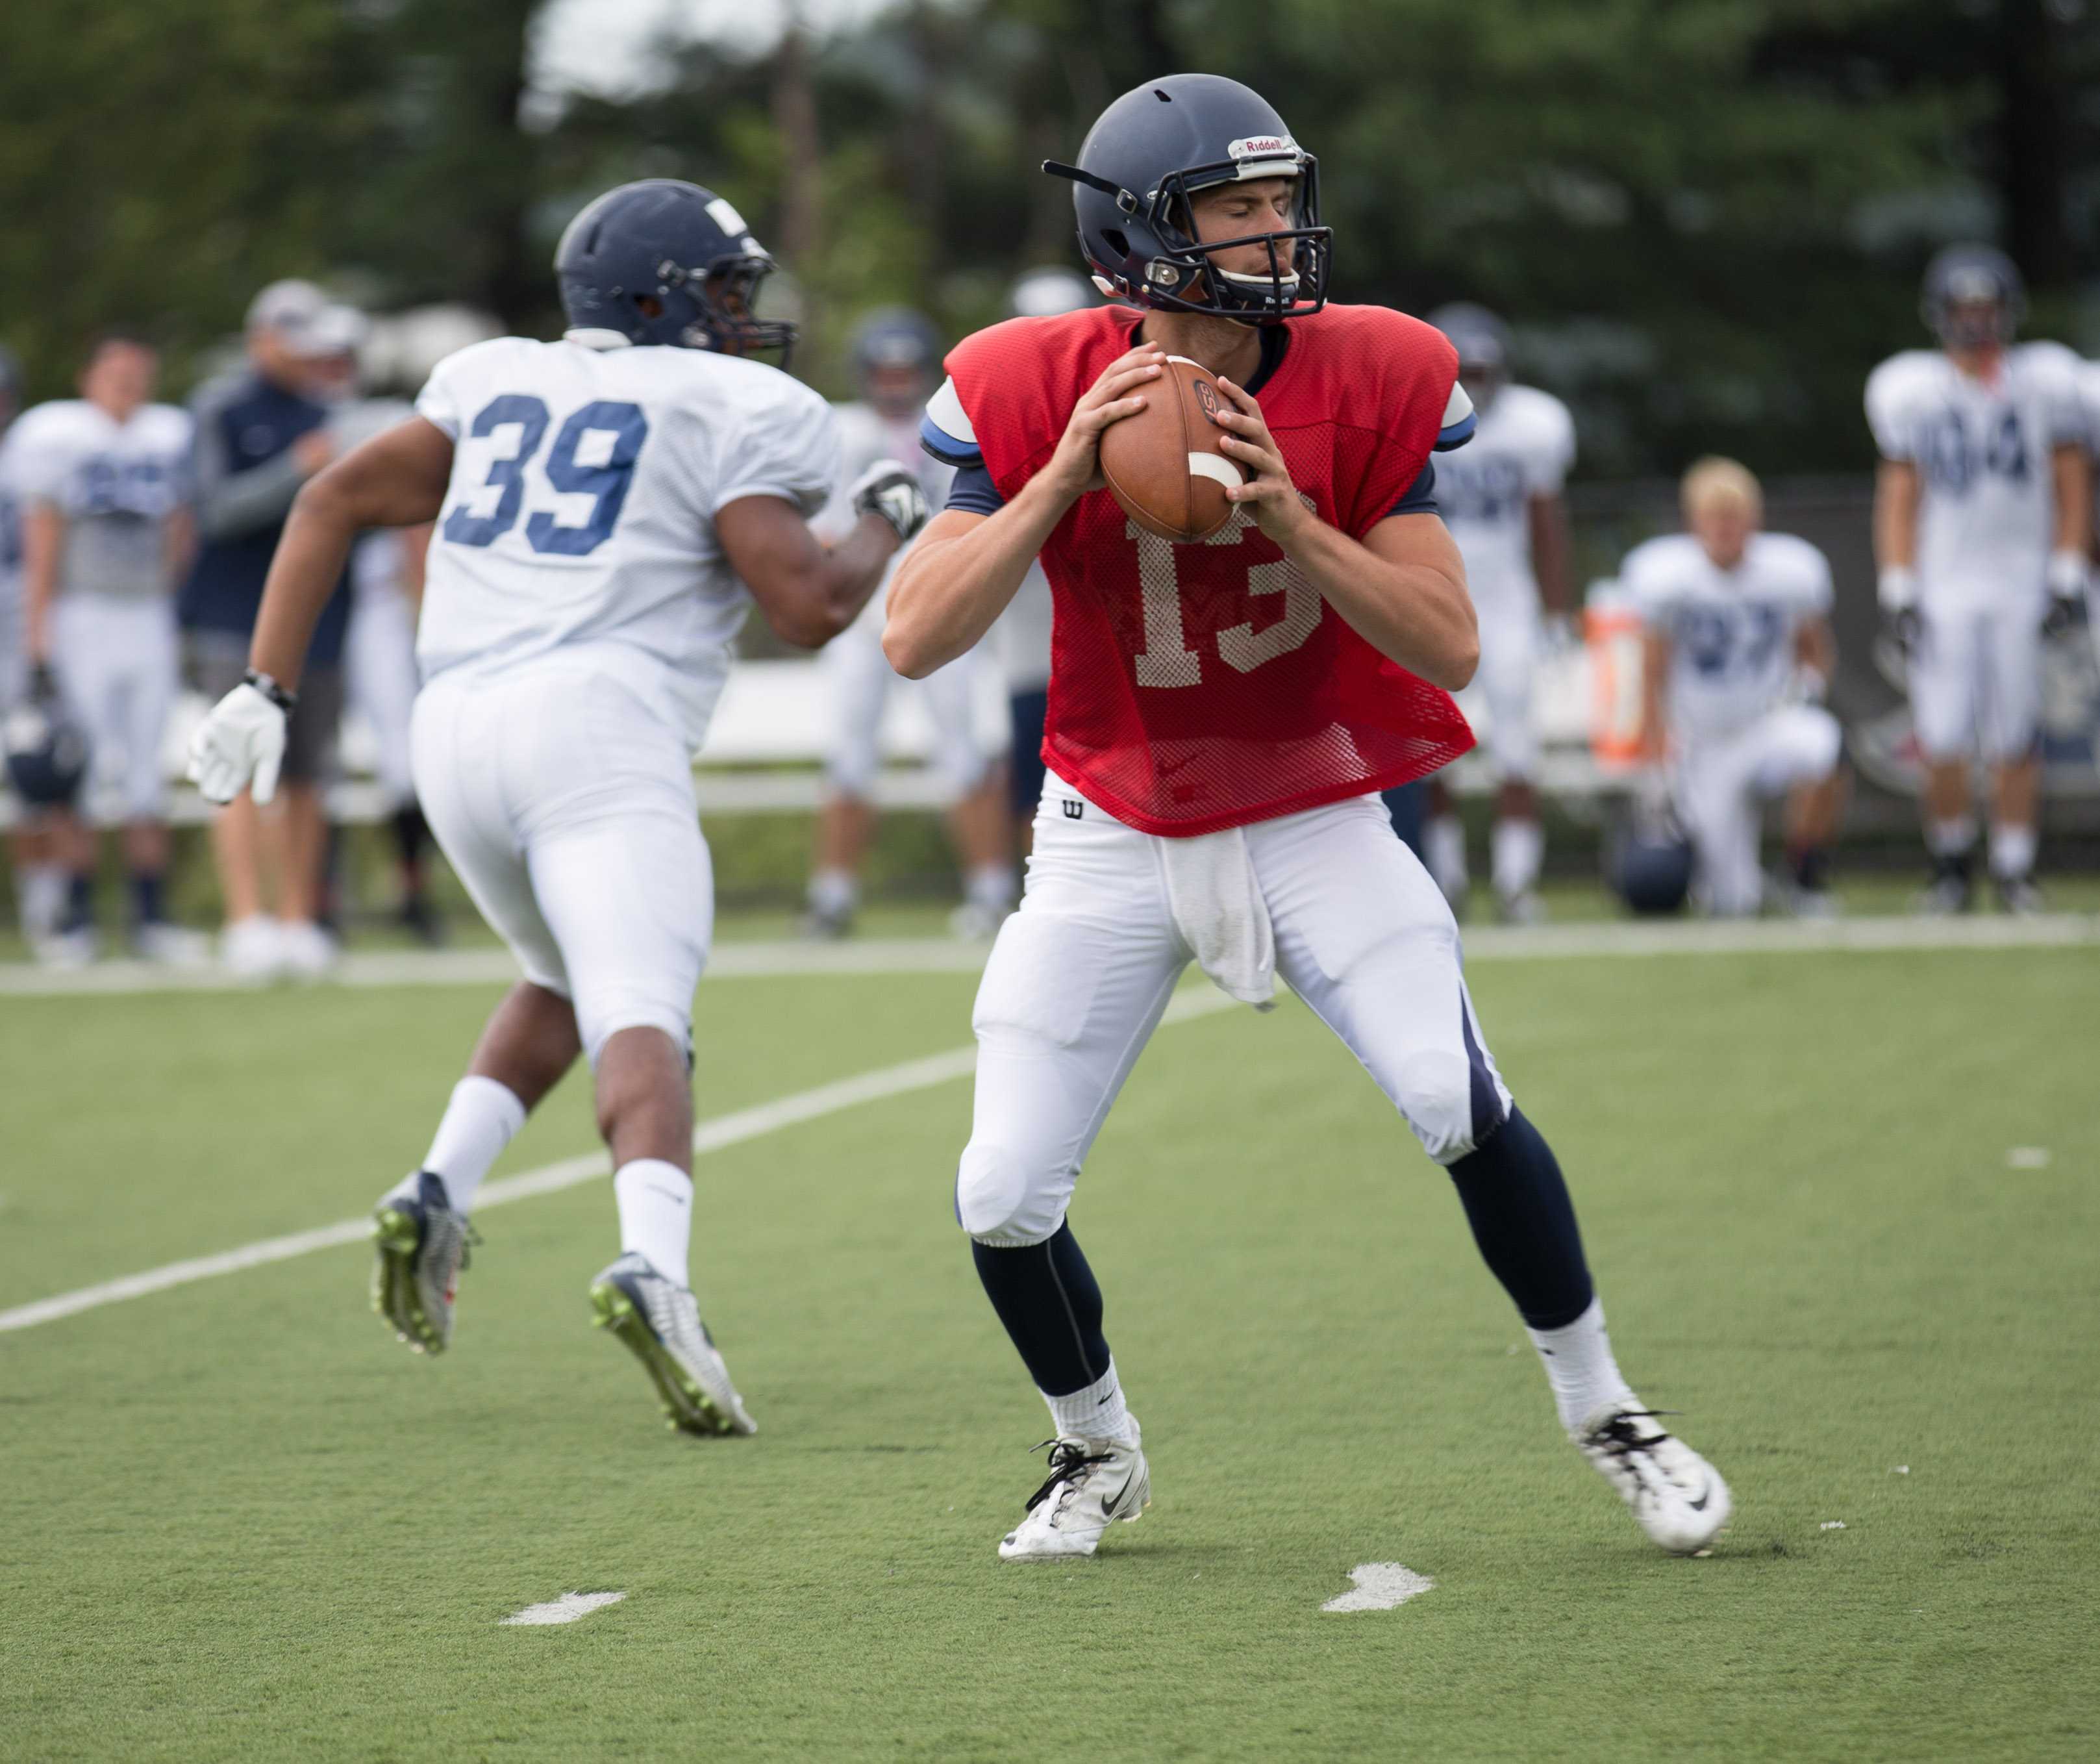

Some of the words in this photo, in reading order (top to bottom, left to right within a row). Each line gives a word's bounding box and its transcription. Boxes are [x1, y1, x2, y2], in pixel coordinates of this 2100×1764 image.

[1246, 140, 1282, 152] Riddell
[444, 394, 648, 556] 39
[1125, 488, 1323, 688] 13
